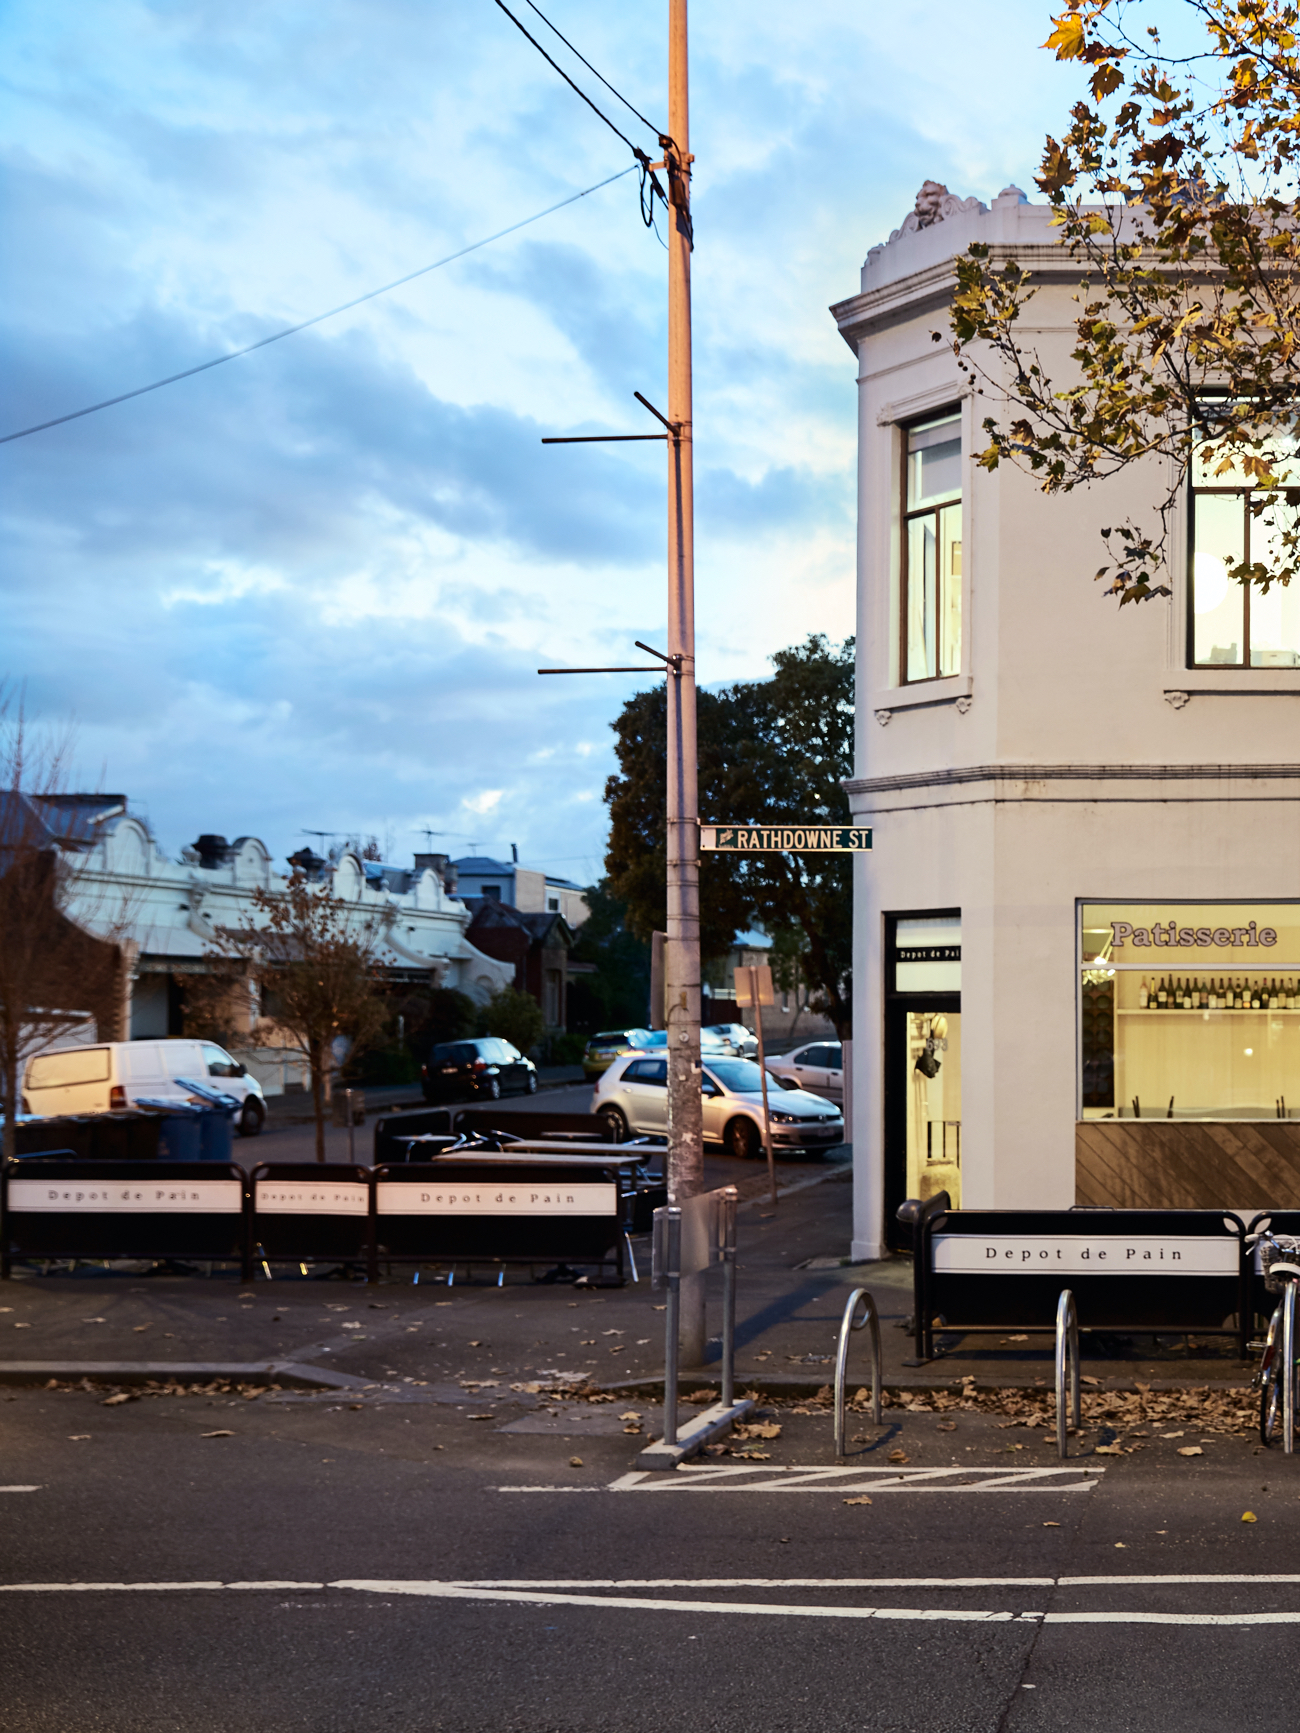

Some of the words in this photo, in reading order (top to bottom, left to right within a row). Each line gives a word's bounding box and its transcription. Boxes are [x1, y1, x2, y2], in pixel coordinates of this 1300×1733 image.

[737, 830, 843, 849] RATHDOWNE
[848, 830, 869, 849] ST
[1110, 921, 1278, 947] Patisserie
[900, 950, 926, 959] Depot
[930, 949, 941, 958] de
[945, 949, 960, 957] Pai
[48, 1189, 108, 1203] Depot
[121, 1189, 143, 1201] de
[155, 1190, 200, 1201] Pain
[260, 1192, 303, 1203] Depot
[312, 1192, 326, 1201] de
[334, 1193, 366, 1203] Pain
[421, 1192, 482, 1205] Depot
[495, 1192, 517, 1203] de
[530, 1193, 576, 1204] Pain
[985, 1247, 1063, 1262] Depot
[1080, 1247, 1107, 1260] de
[1126, 1248, 1182, 1260] Pain
